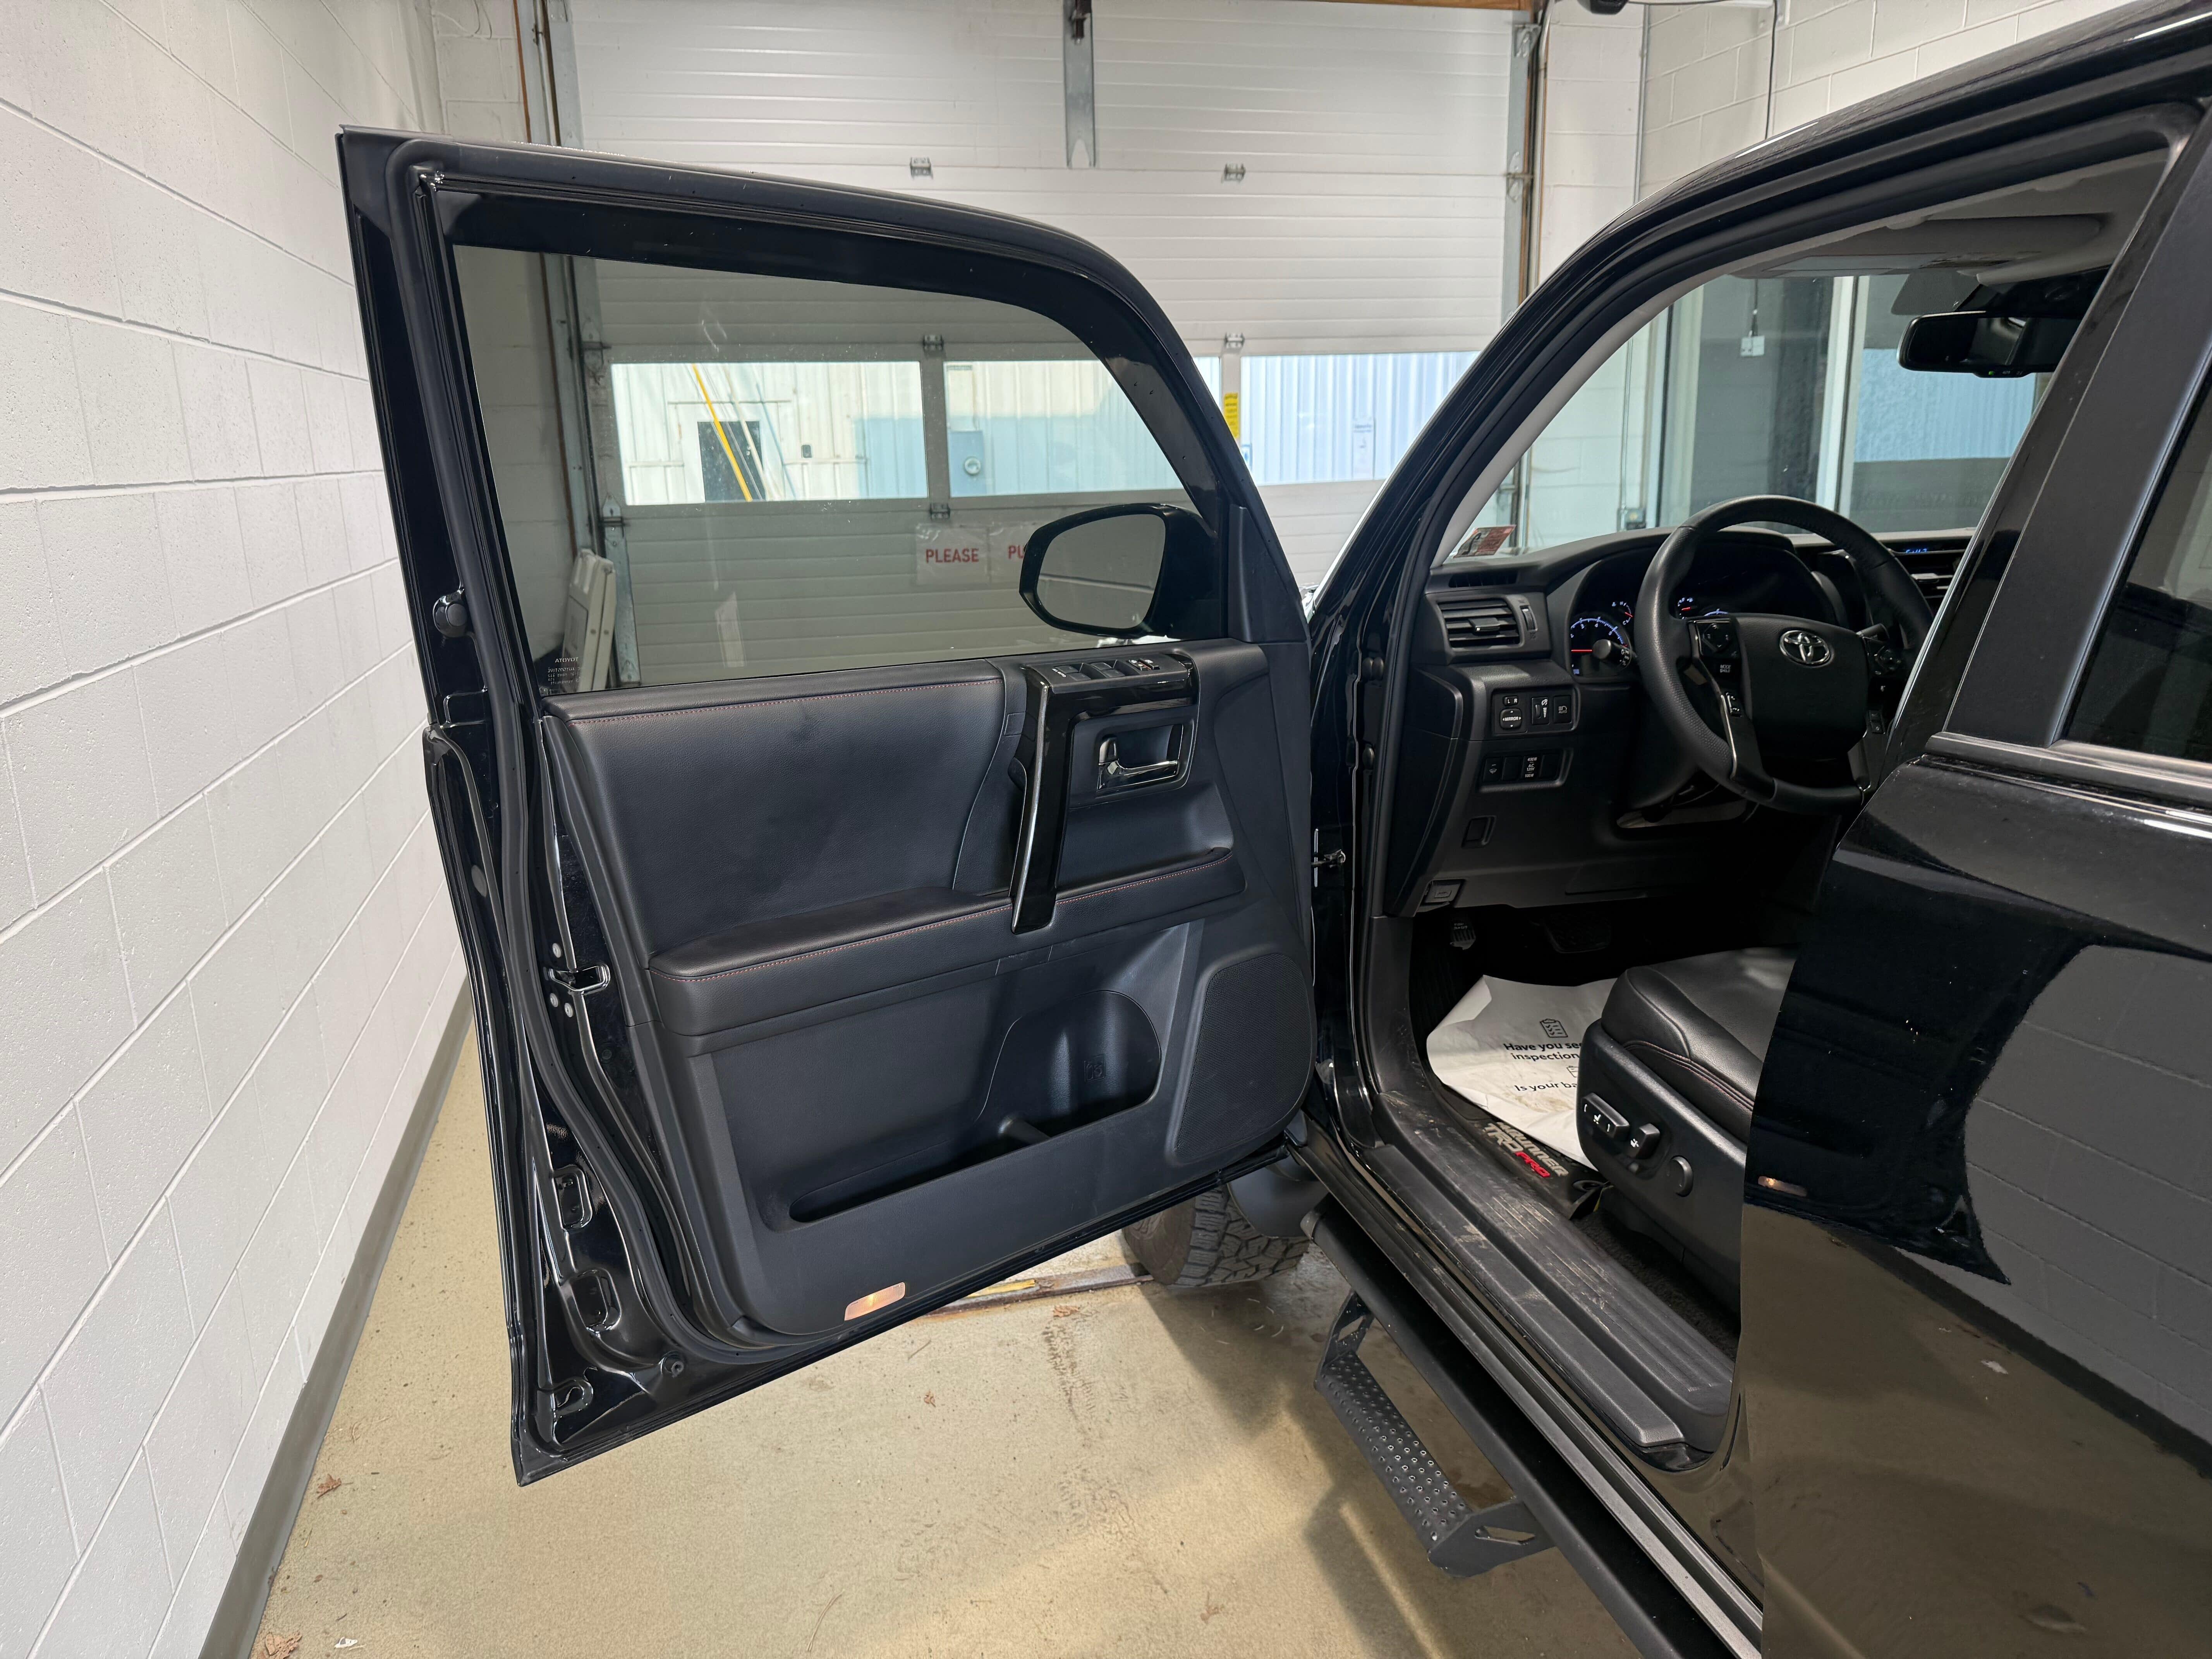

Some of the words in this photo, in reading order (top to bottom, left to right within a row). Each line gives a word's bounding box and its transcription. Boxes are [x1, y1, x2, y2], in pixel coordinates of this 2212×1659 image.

[926, 548, 979, 563] PLEASE
[1538, 1042, 1563, 1052] you
[1511, 1052, 1580, 1061] inspection
[1528, 1083, 1559, 1092] your
[1482, 1123, 1524, 1153] TRD
[1515, 1151, 1550, 1178] PRO
